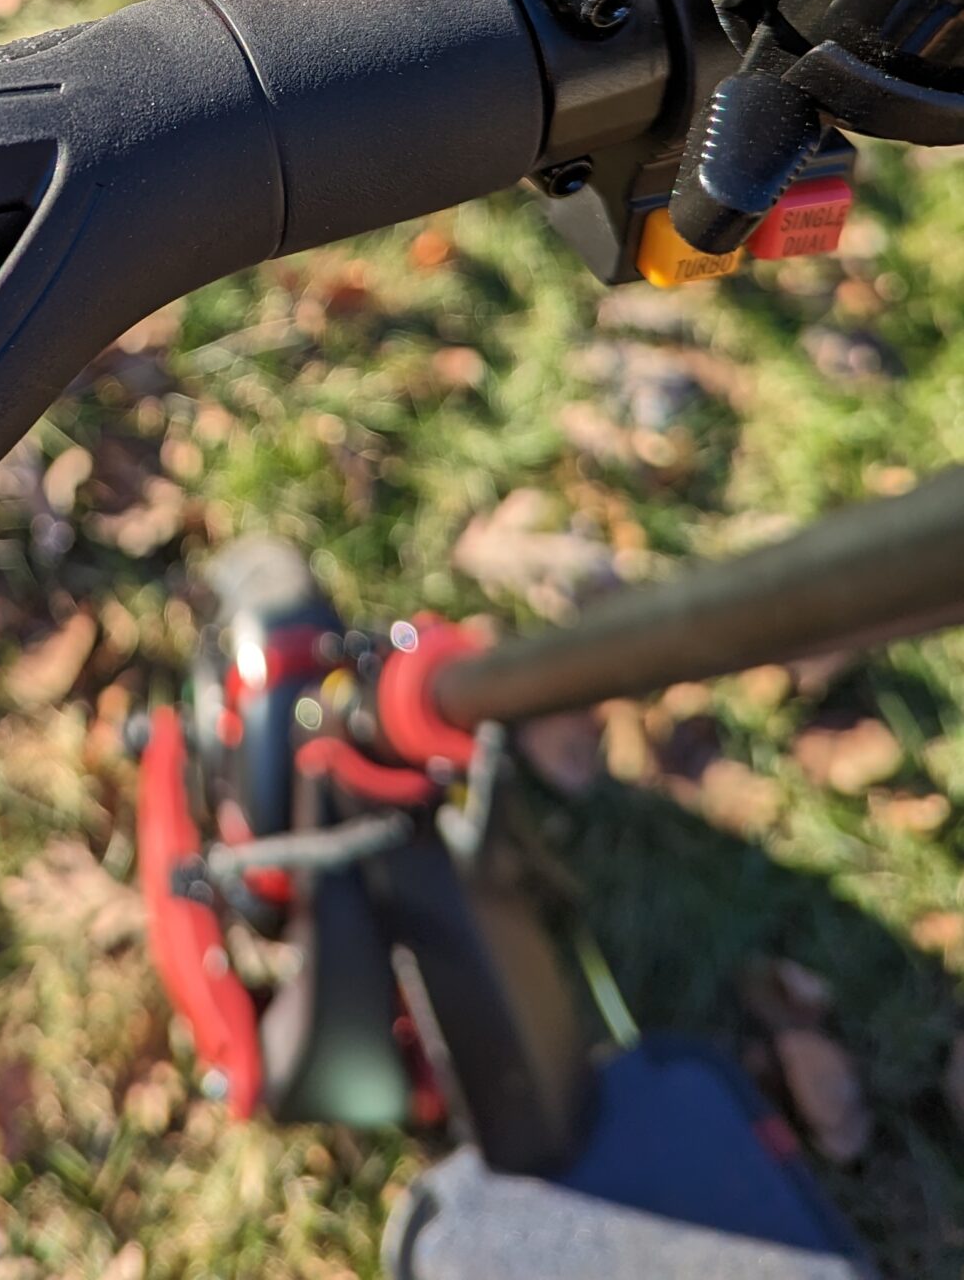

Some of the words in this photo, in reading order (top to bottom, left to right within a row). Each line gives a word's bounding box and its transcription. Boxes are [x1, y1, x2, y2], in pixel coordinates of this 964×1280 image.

[782, 204, 849, 232] SINGLE
[783, 235, 829, 257] DUAL
[673, 253, 733, 281] TURBO
